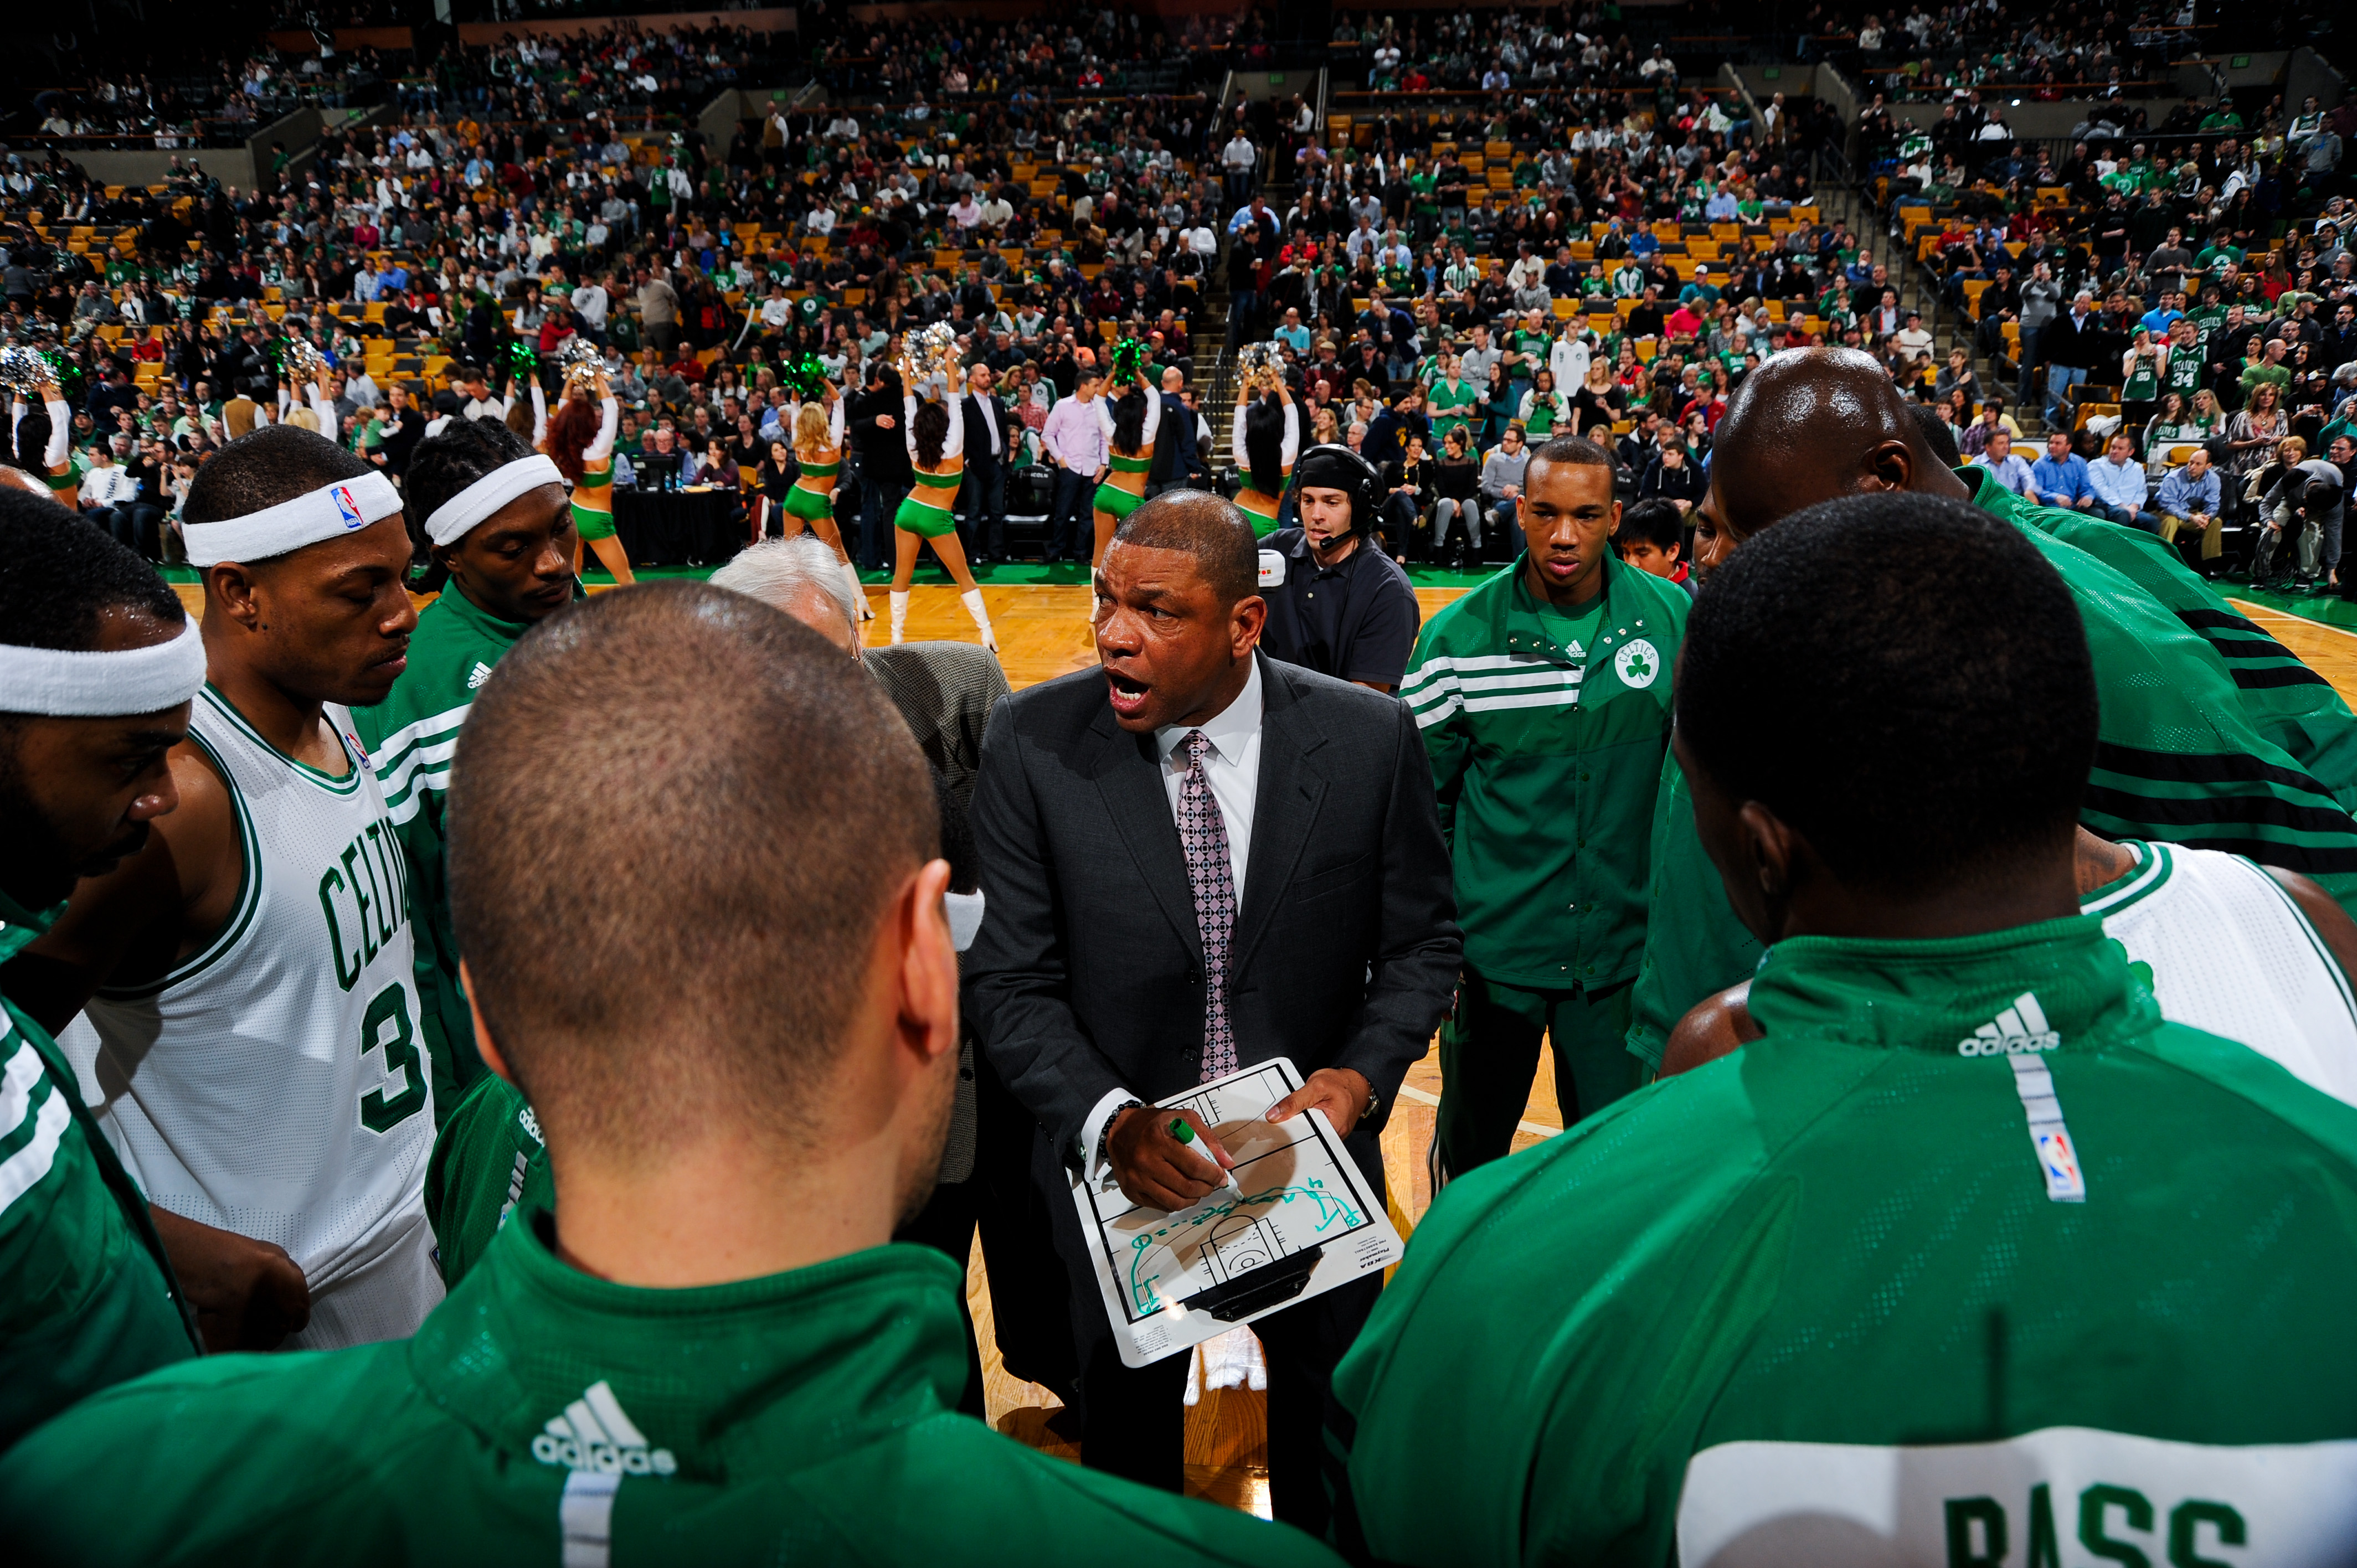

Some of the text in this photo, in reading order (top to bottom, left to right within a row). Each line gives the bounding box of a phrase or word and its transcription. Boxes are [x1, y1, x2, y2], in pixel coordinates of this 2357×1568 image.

[2199, 317, 2221, 329] CELTICS
[2136, 371, 2151, 381] 20
[2173, 360, 2199, 378] CELTICS
[2171, 372, 2194, 387] 34
[345, 518, 360, 526] NBA
[1619, 642, 1655, 663] CELTICS
[1958, 1030, 2060, 1056] adidas
[532, 1433, 678, 1476] adidas
